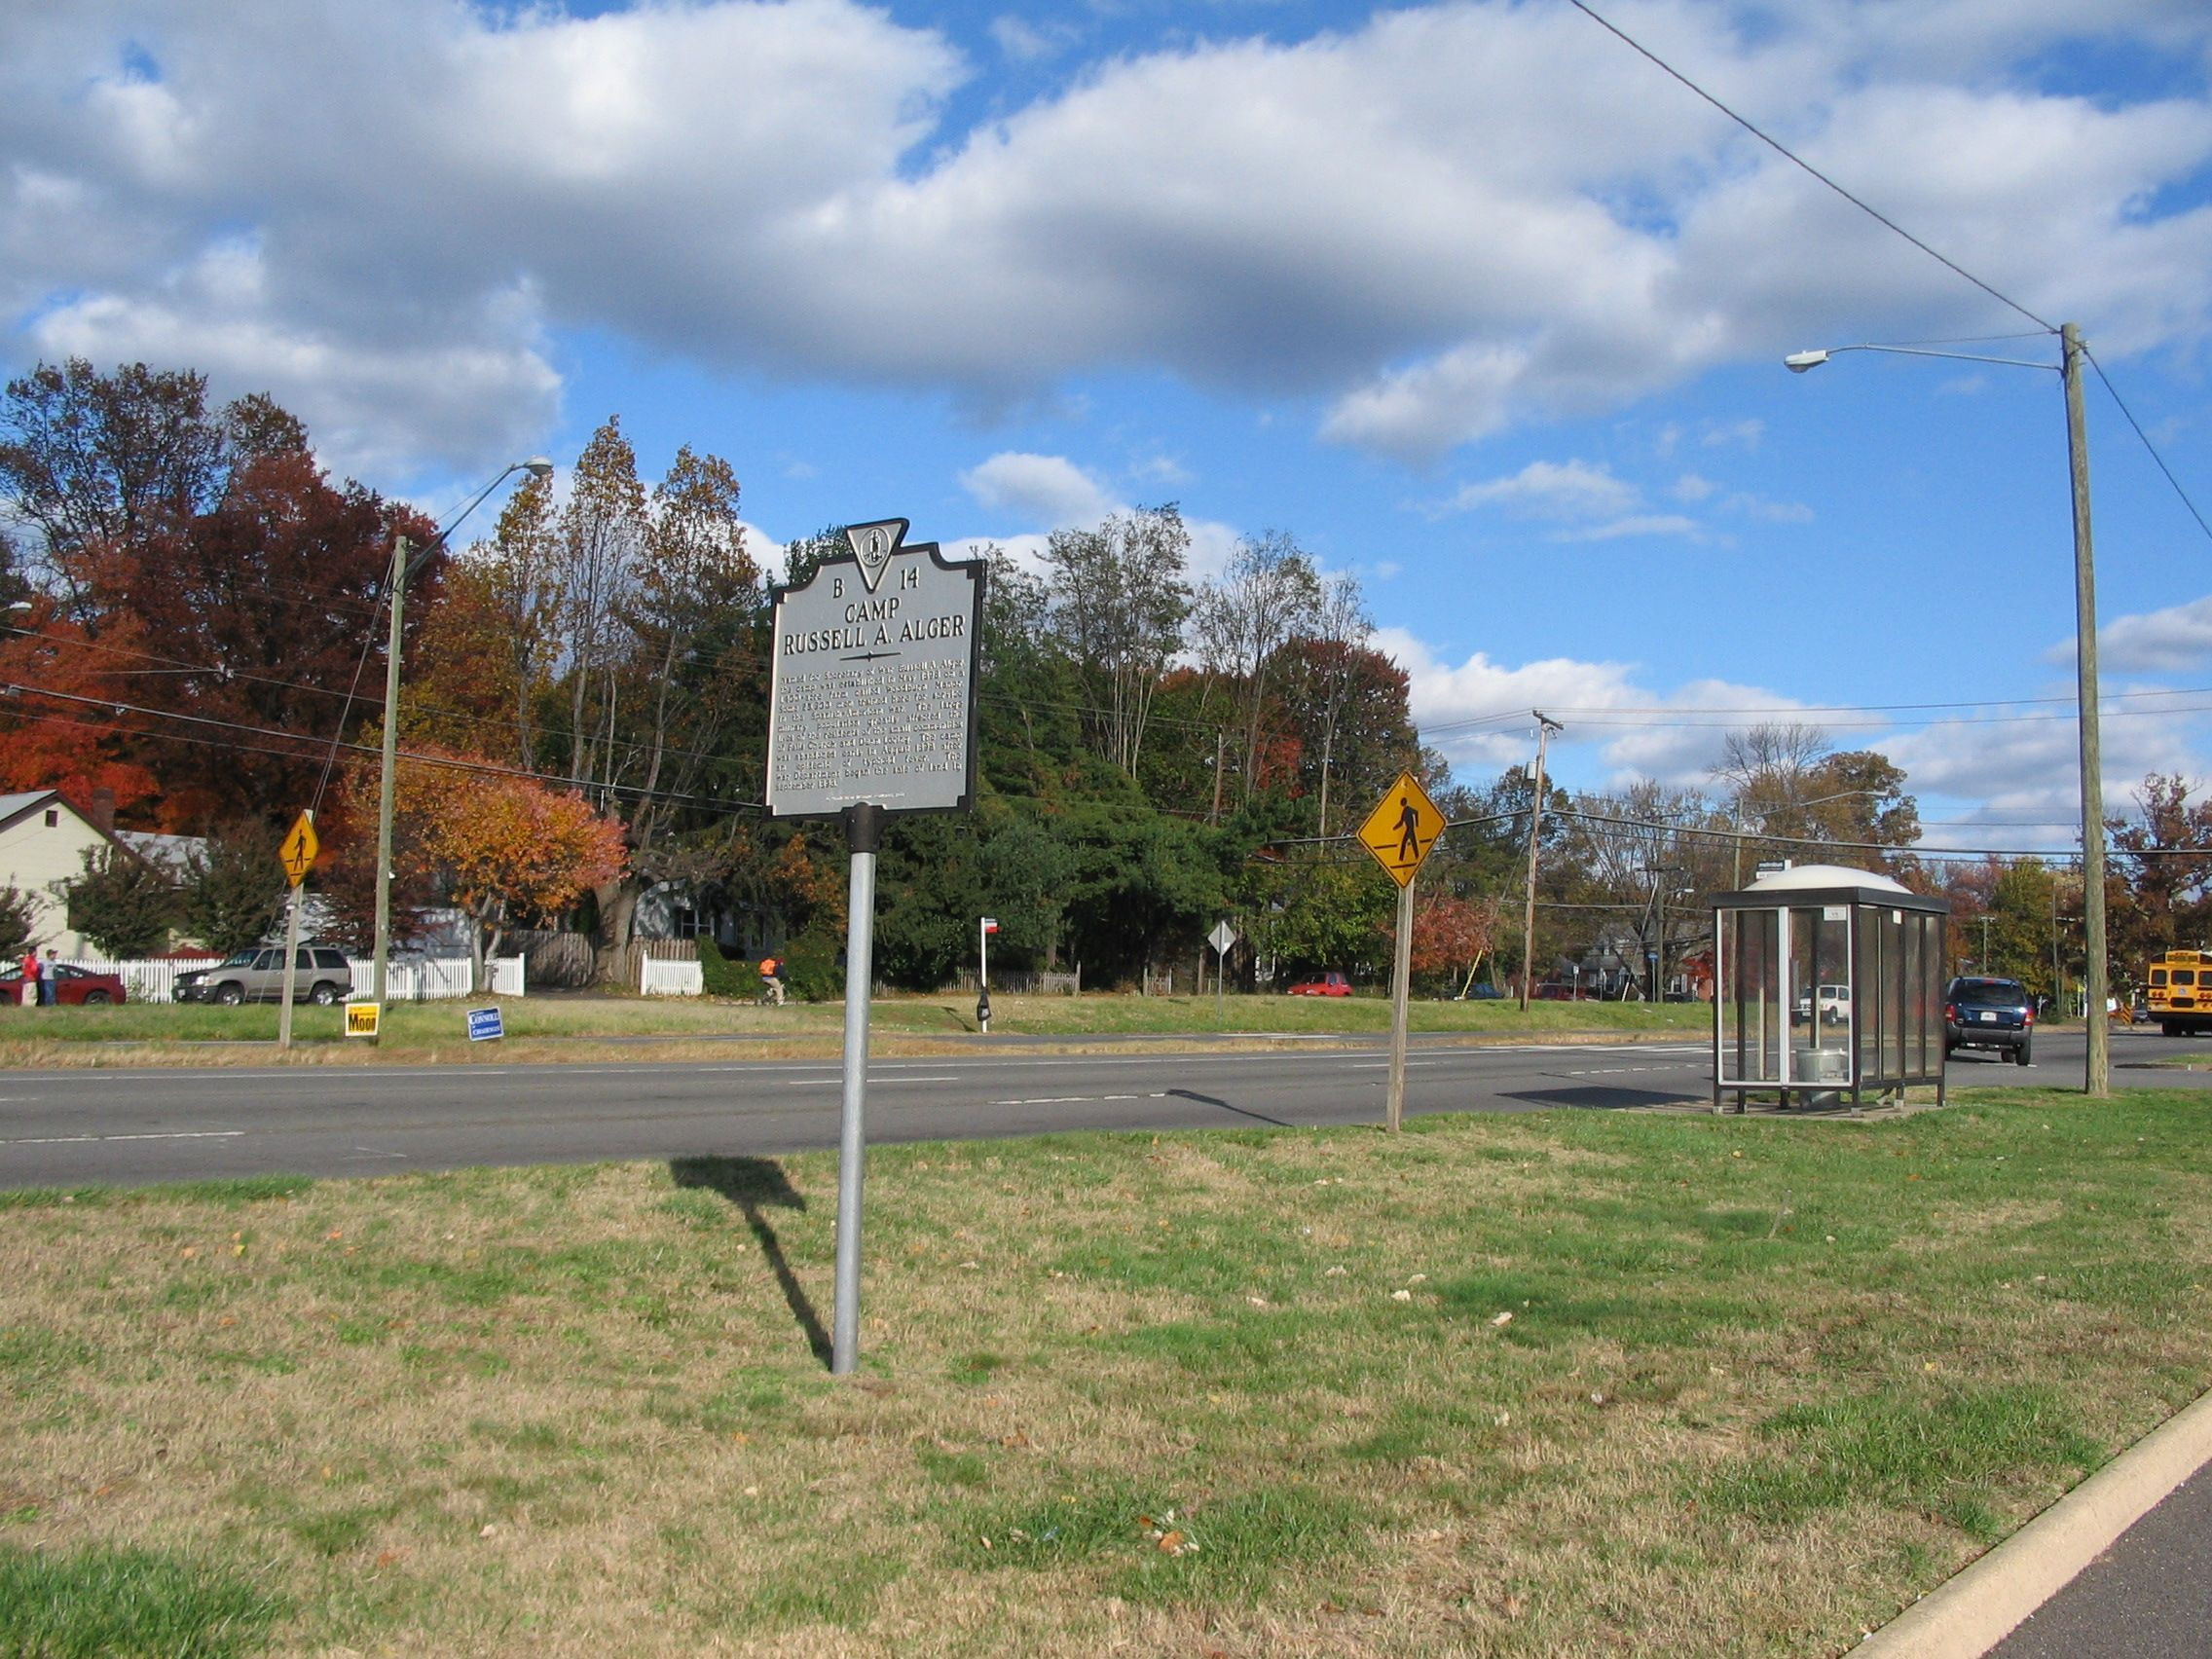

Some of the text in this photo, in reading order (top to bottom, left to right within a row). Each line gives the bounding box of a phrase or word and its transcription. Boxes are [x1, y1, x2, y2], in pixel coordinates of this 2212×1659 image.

[833, 567, 919, 598] B 14
[844, 597, 902, 624] CAMP
[784, 614, 966, 655] RUSSELL A. ALGER
